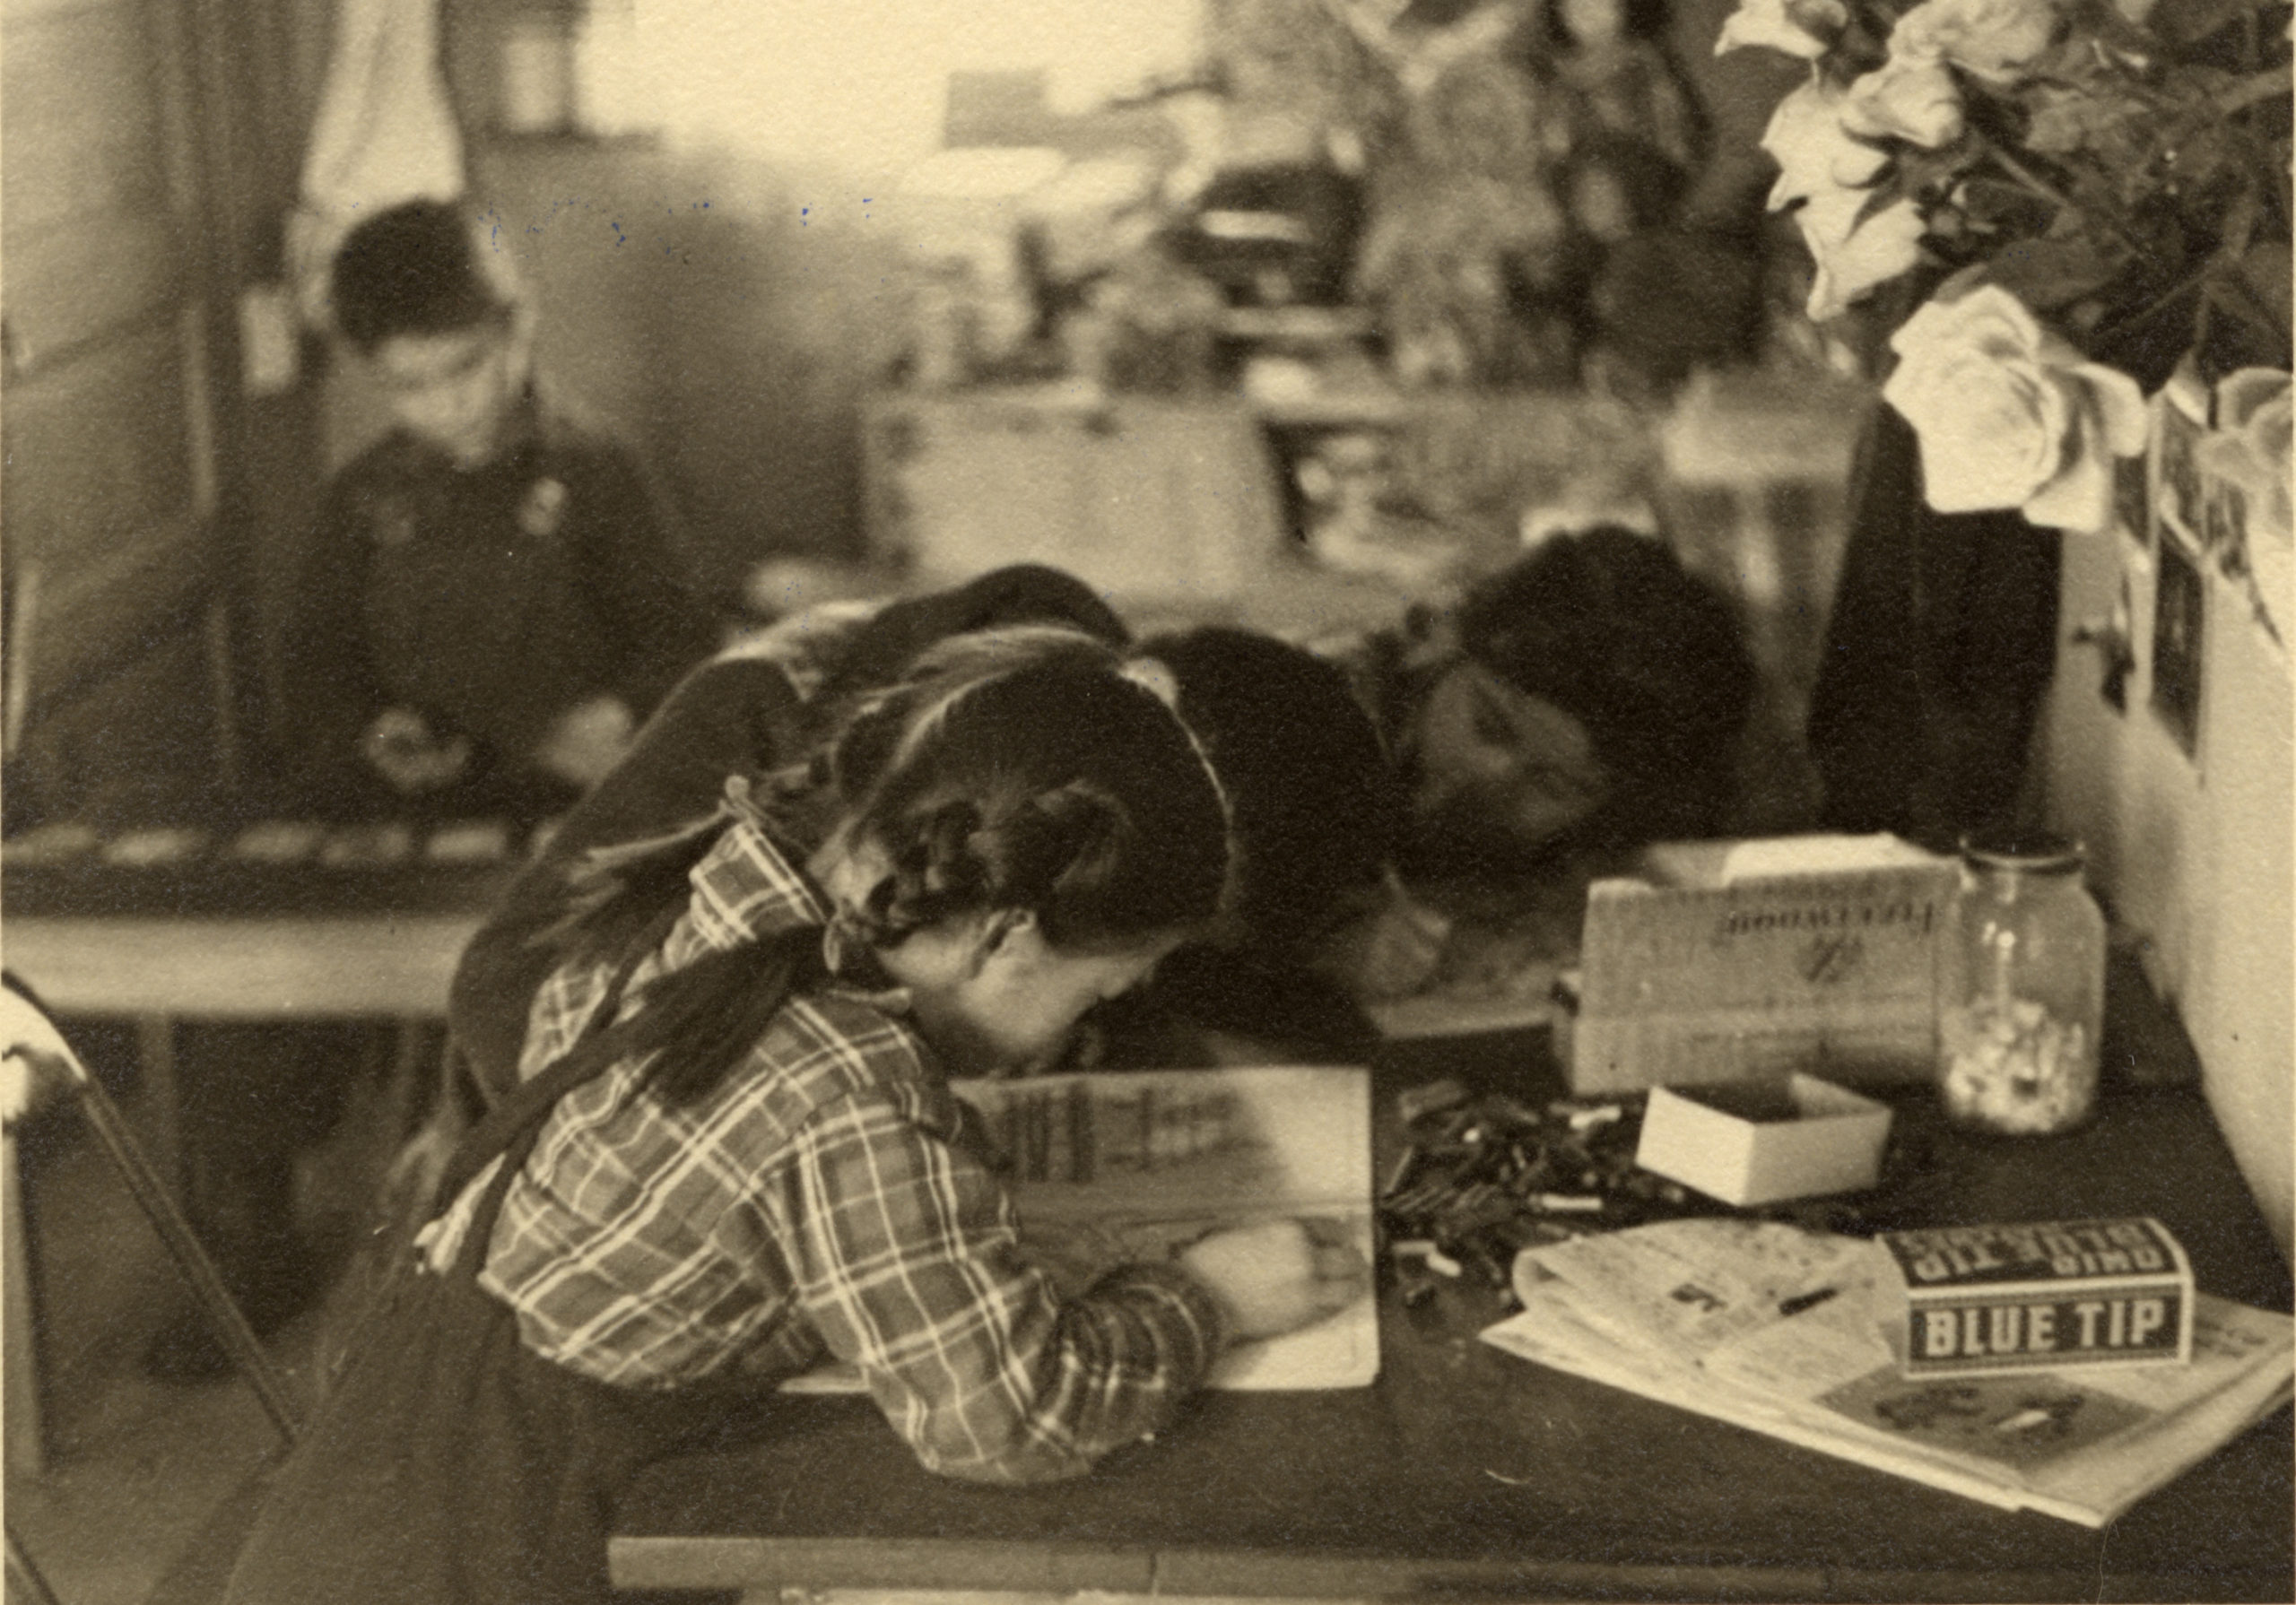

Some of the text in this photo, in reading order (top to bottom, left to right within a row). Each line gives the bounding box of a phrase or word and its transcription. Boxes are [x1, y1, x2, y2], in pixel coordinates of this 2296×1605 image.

[1913, 1236, 2005, 1281] TIP
[1925, 1298, 2165, 1357] BLUE TIP
